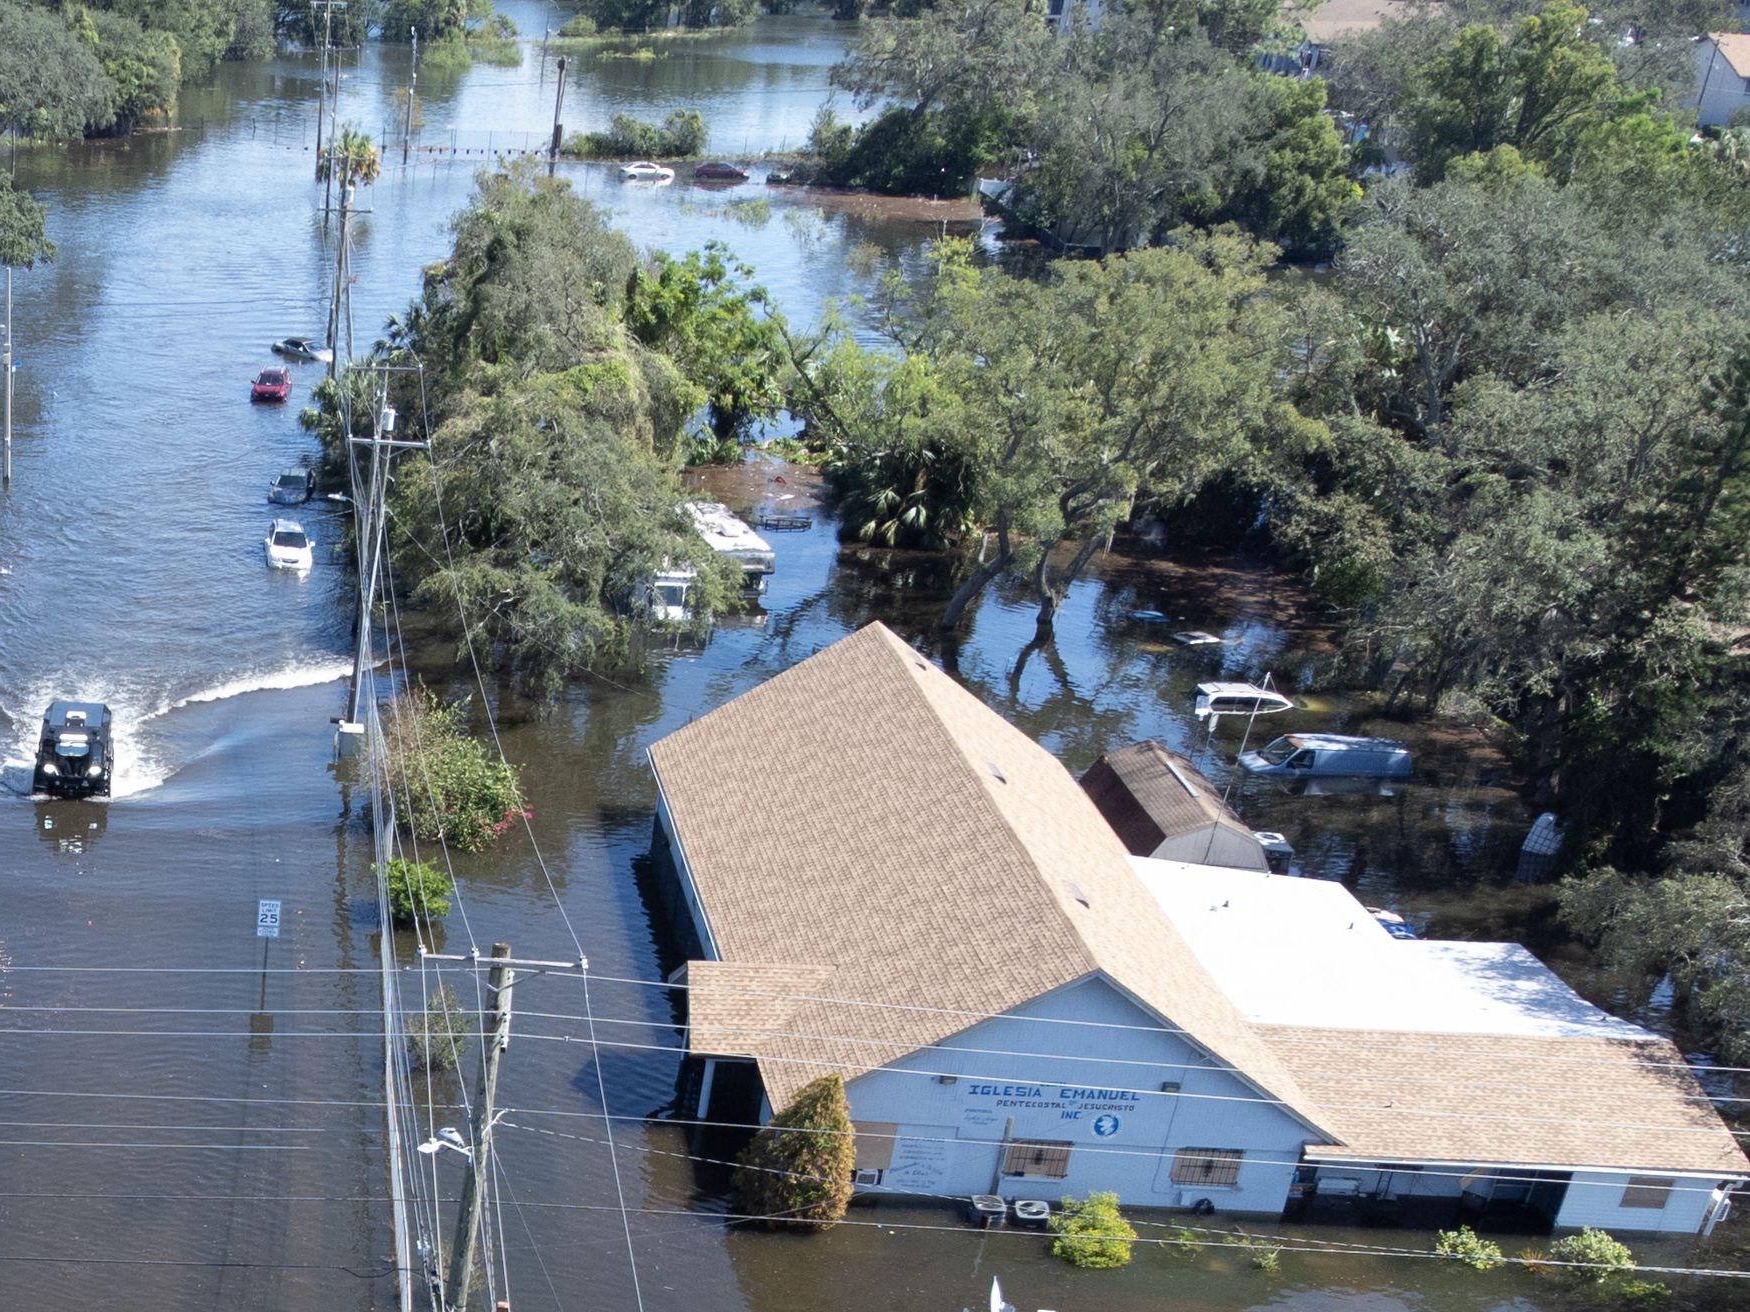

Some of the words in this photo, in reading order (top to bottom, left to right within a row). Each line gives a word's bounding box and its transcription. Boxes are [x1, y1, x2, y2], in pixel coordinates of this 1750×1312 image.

[260, 913, 278, 924] 25
[969, 1085, 1042, 1098] IGLESIA
[1060, 1088, 1140, 1101] EMANUEL
[996, 1100, 1066, 1109] PENTECOSTAL
[1078, 1102, 1135, 1111] JESUCRISTO
